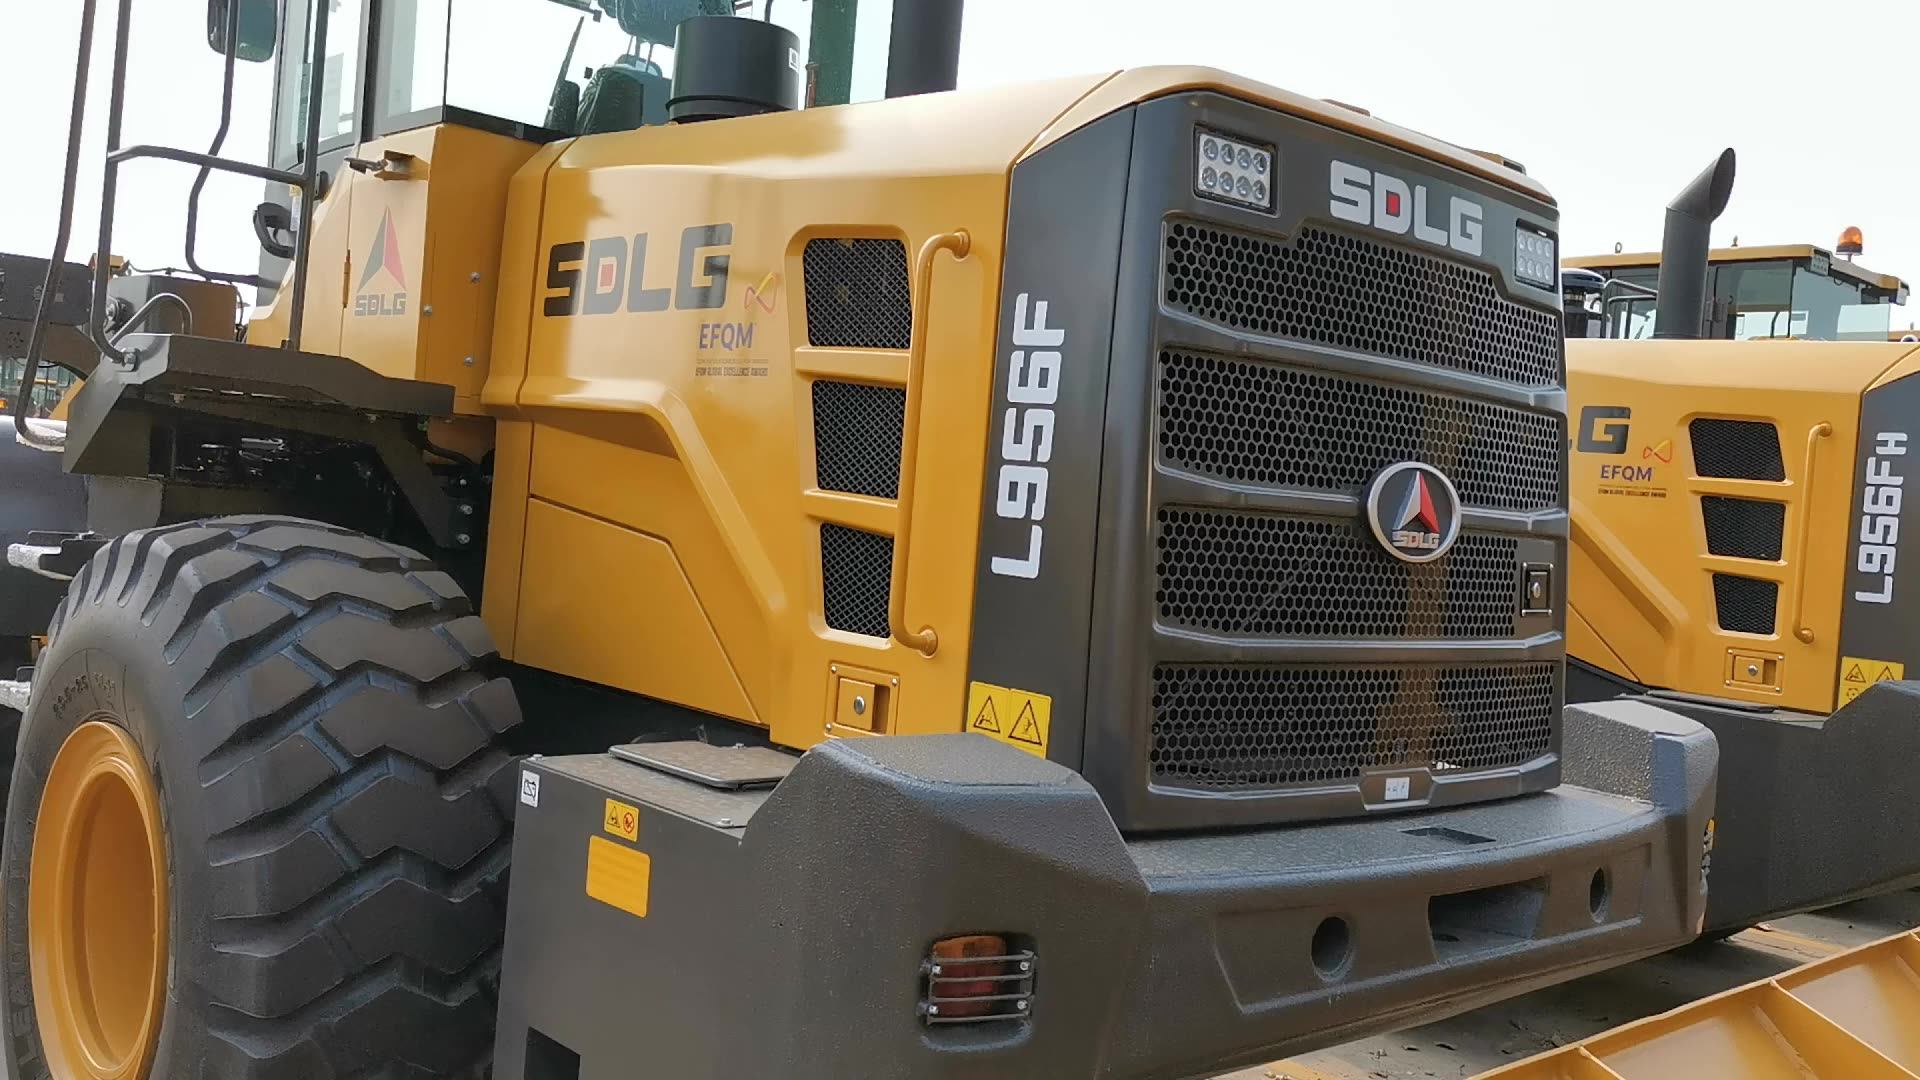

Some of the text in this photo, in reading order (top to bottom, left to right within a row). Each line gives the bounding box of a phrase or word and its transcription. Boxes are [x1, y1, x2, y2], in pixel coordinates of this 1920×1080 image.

[1330, 159, 1483, 257] SDLG
[544, 223, 732, 317] SDLG
[354, 292, 407, 317] SDLG
[699, 322, 753, 351] EFQM
[991, 293, 1064, 579] L956F
[1600, 465, 1652, 482] EFQM
[1392, 530, 1441, 550] SDLG
[1855, 432, 1908, 603] L956FH
